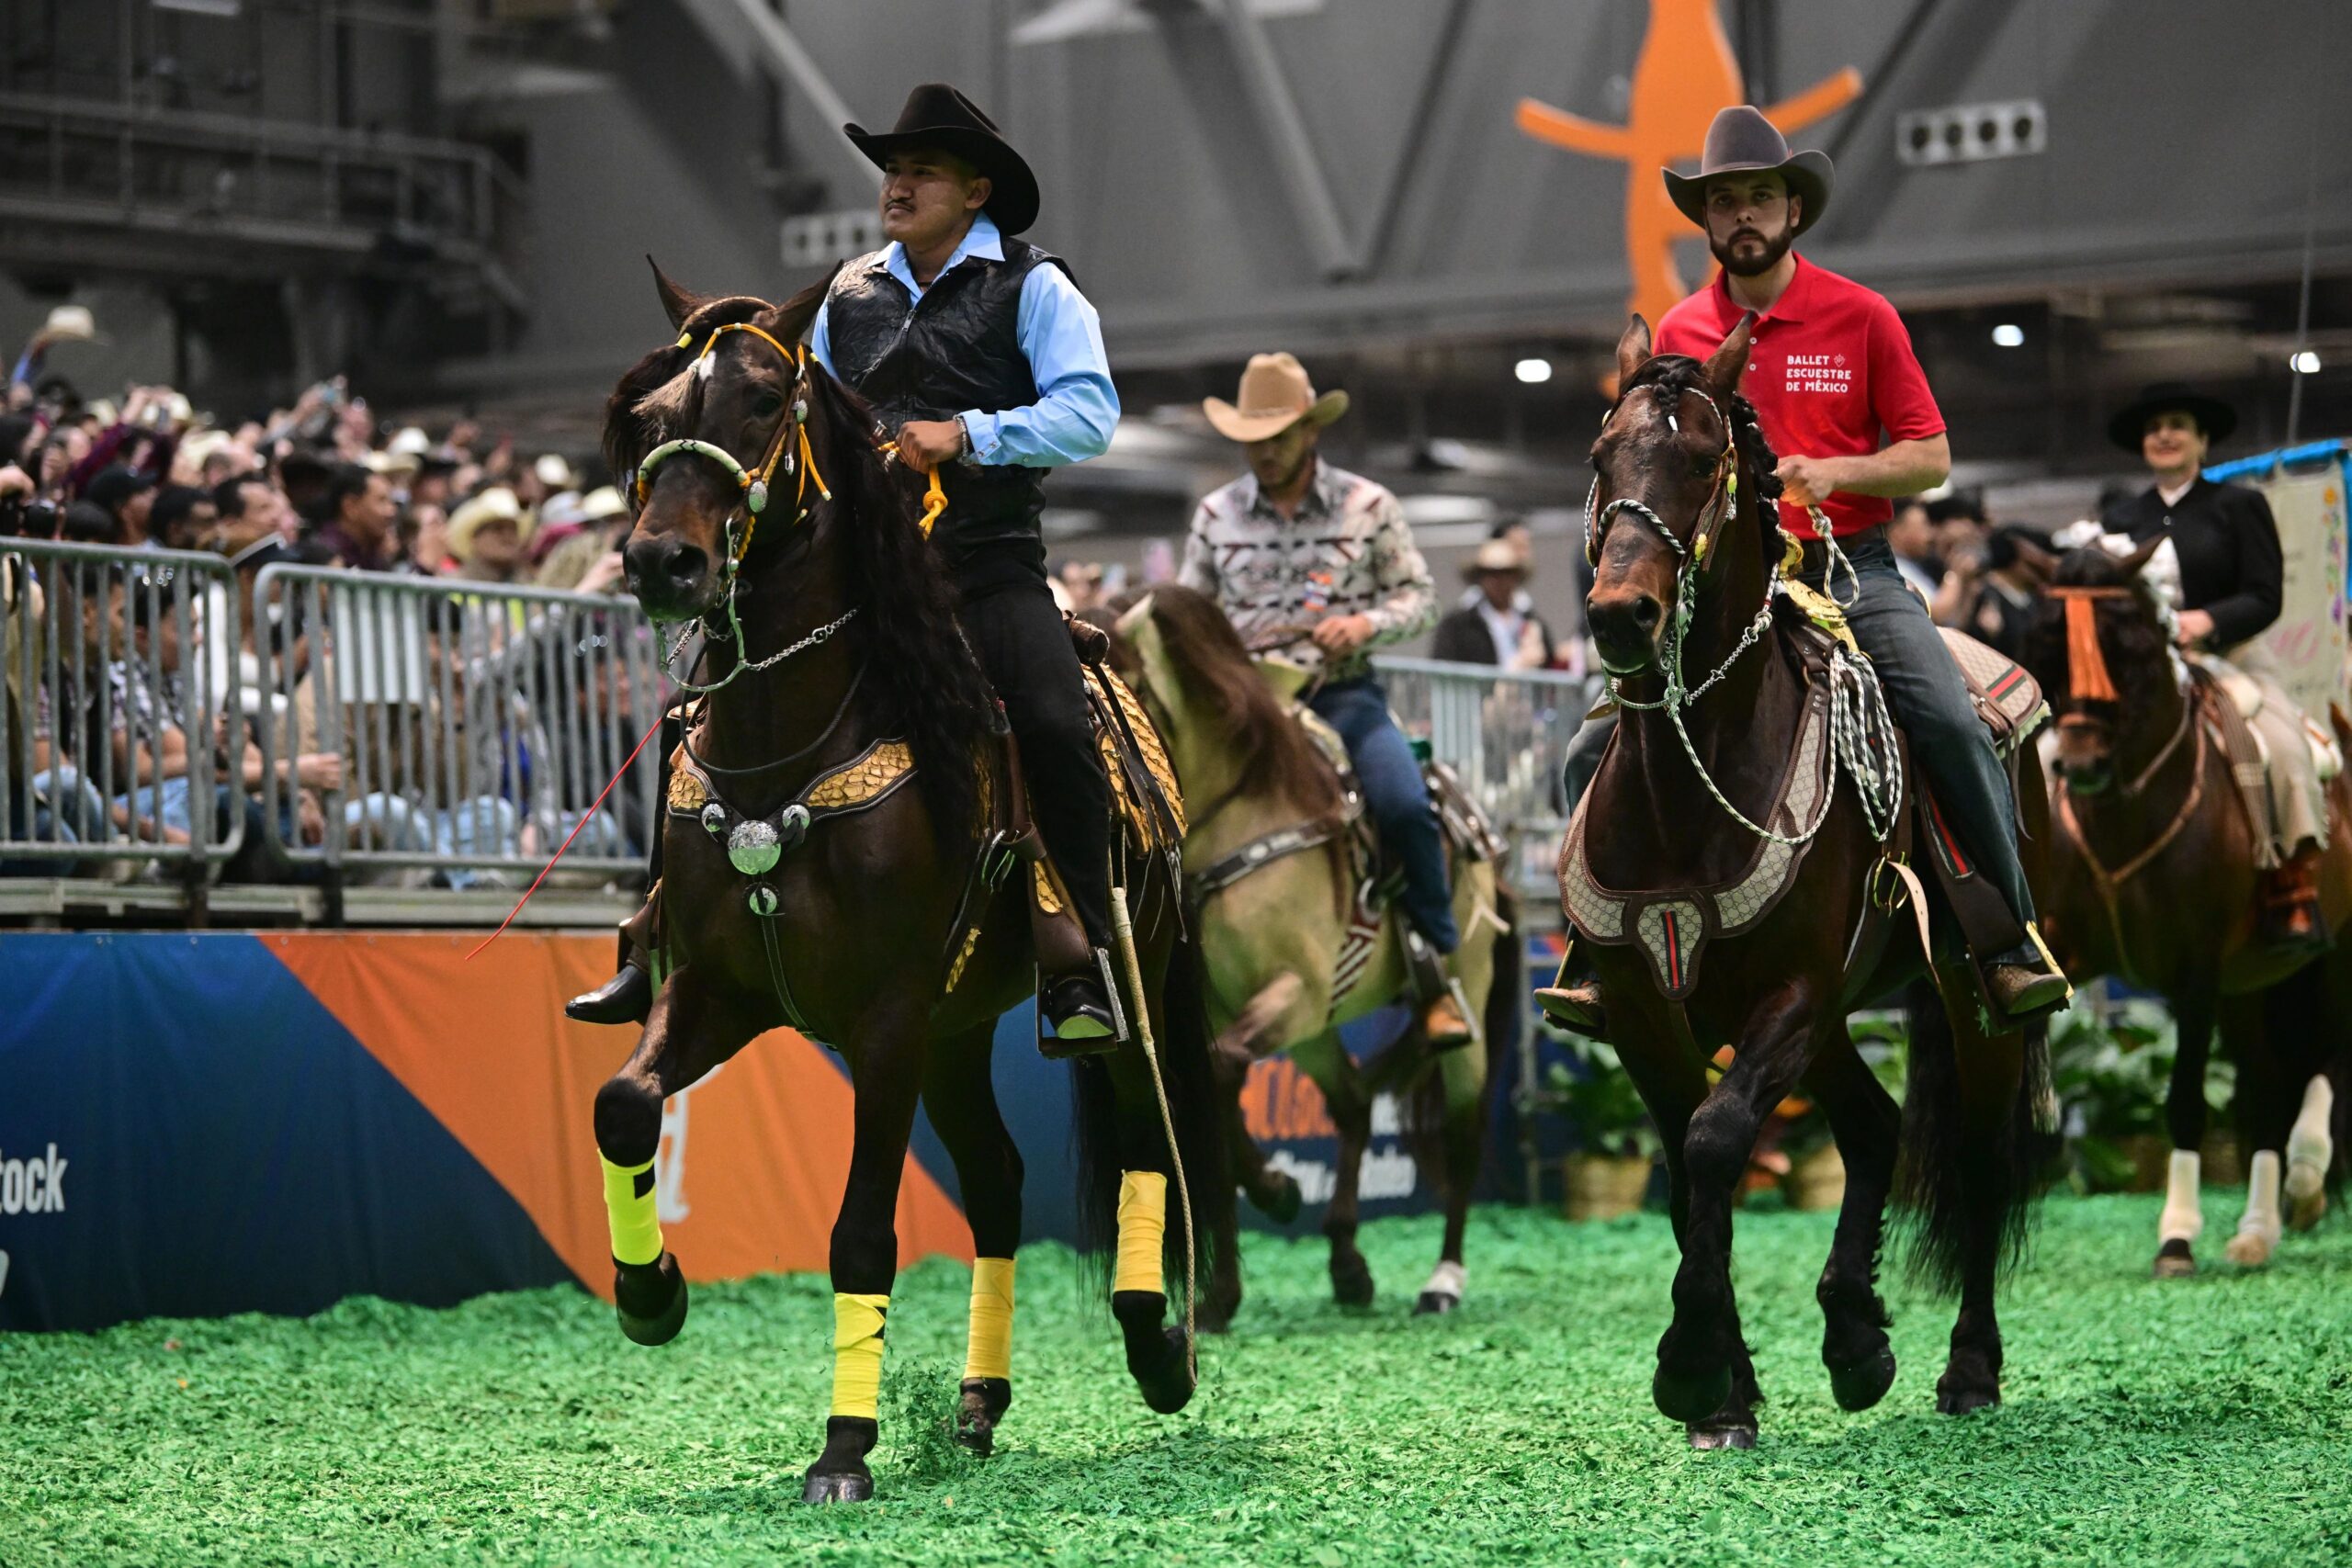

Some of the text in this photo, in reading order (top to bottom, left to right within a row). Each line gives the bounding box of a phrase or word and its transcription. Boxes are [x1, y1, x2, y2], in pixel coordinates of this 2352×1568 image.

[1787, 355, 1829, 366] BALLET
[1786, 368, 1851, 380] ESCUESTRE
[1786, 379, 1849, 393] DE MÉXICO
[0, 1142, 69, 1215] ock
